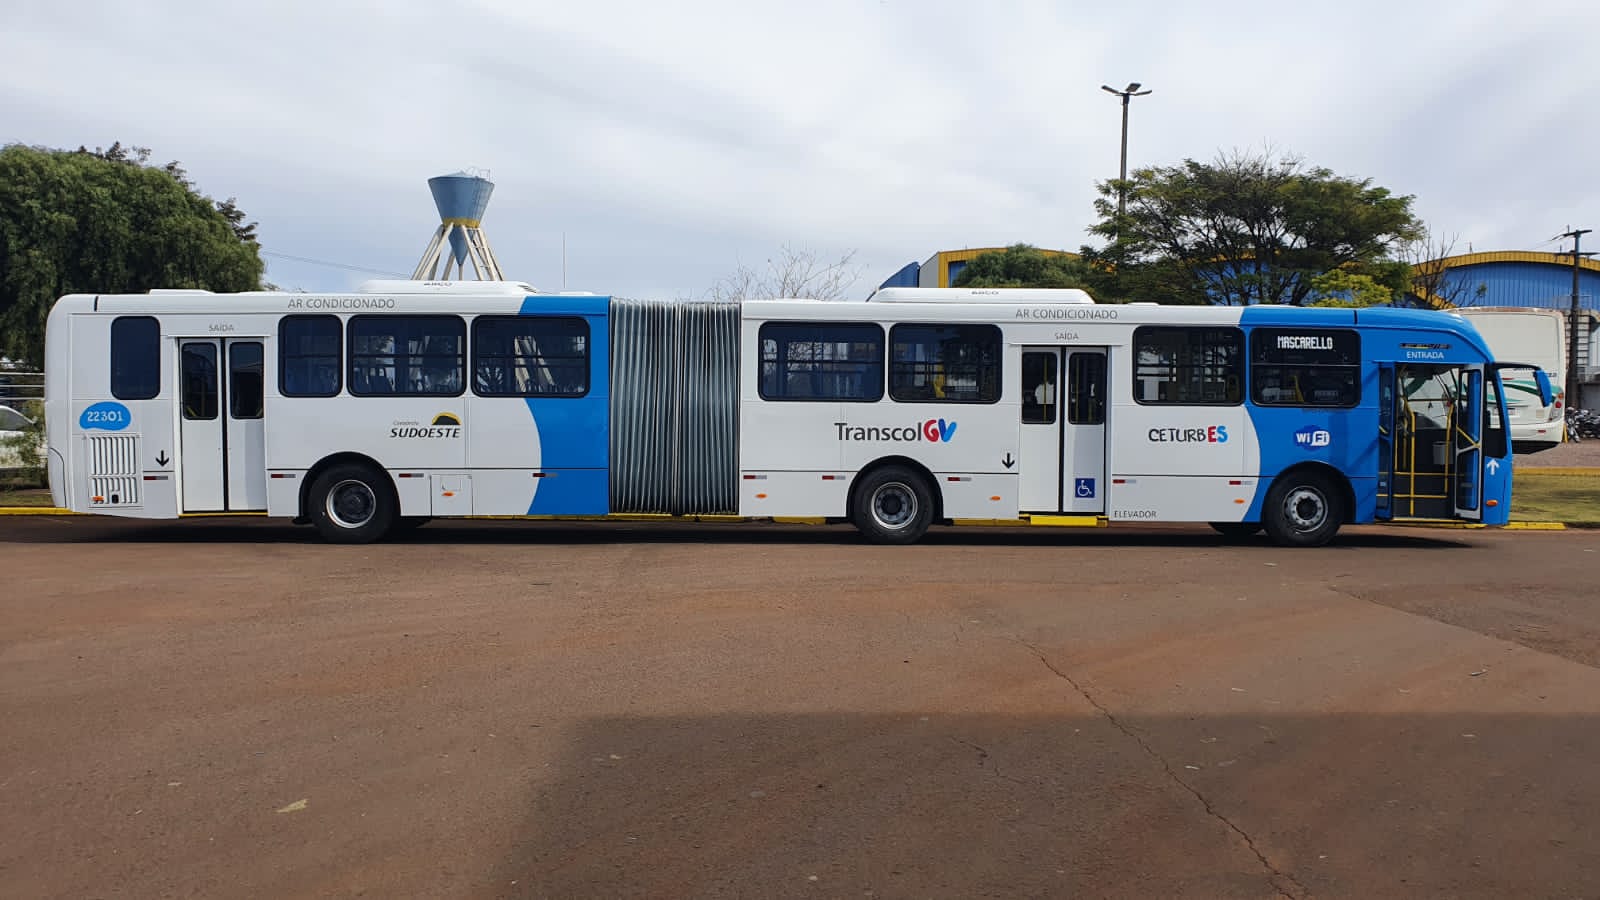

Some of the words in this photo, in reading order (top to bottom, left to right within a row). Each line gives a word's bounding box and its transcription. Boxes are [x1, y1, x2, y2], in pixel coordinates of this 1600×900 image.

[287, 298, 303, 309] AR
[306, 298, 395, 309] CONDICIONADO
[1015, 308, 1030, 319] AR
[1032, 309, 1118, 320] CONDICIONADO
[1054, 329, 1080, 341] SAÍDA
[1277, 336, 1334, 350] MASCARELLO
[1406, 351, 1445, 360] ENTRADA
[87, 410, 123, 422] 22301
[390, 427, 461, 438] SUDOESTE
[833, 418, 957, 443] TranscolGV
[1114, 510, 1157, 518] ELEVADOR
